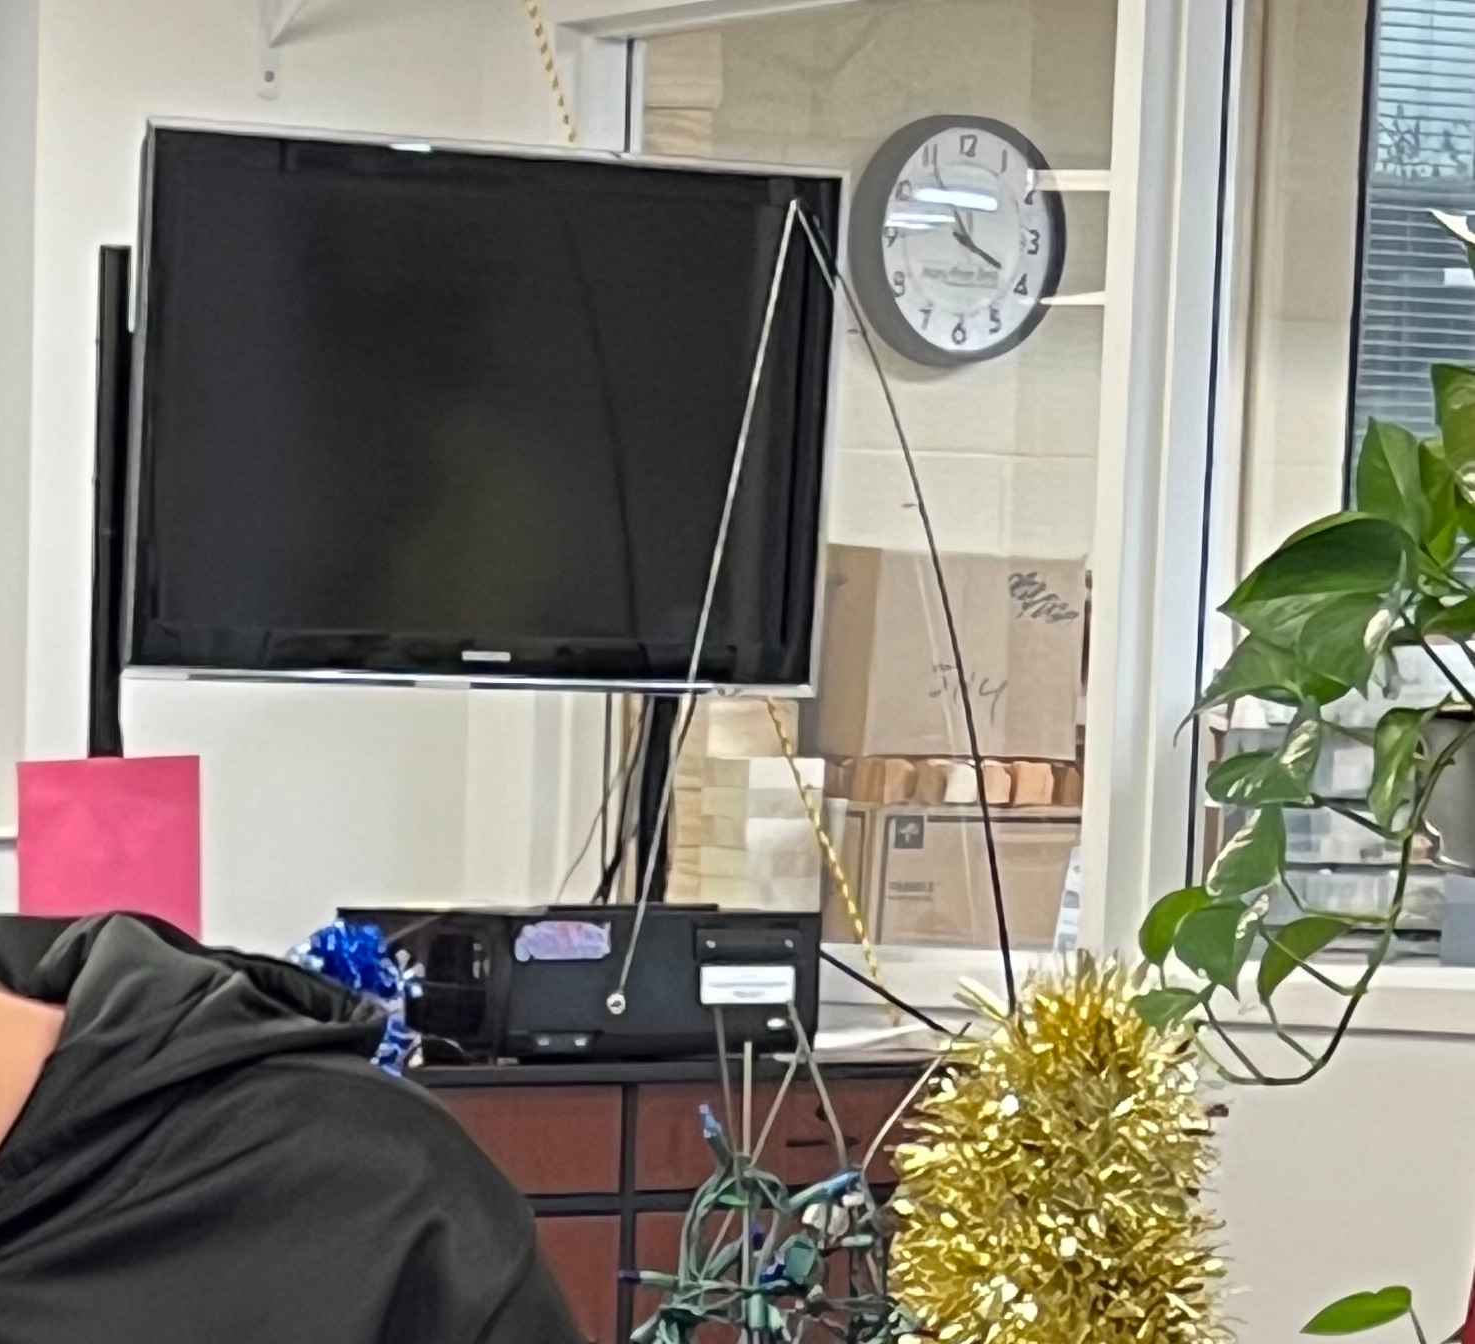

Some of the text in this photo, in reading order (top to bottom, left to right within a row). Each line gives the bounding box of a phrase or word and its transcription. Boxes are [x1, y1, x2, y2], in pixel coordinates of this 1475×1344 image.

[1001, 149, 1008, 173] 1
[883, 224, 899, 249] 9
[1026, 228, 1041, 255] 3
[1013, 272, 1028, 296] 4
[918, 307, 933, 331] 7
[951, 315, 967, 345] 6
[988, 304, 1003, 334] 5
